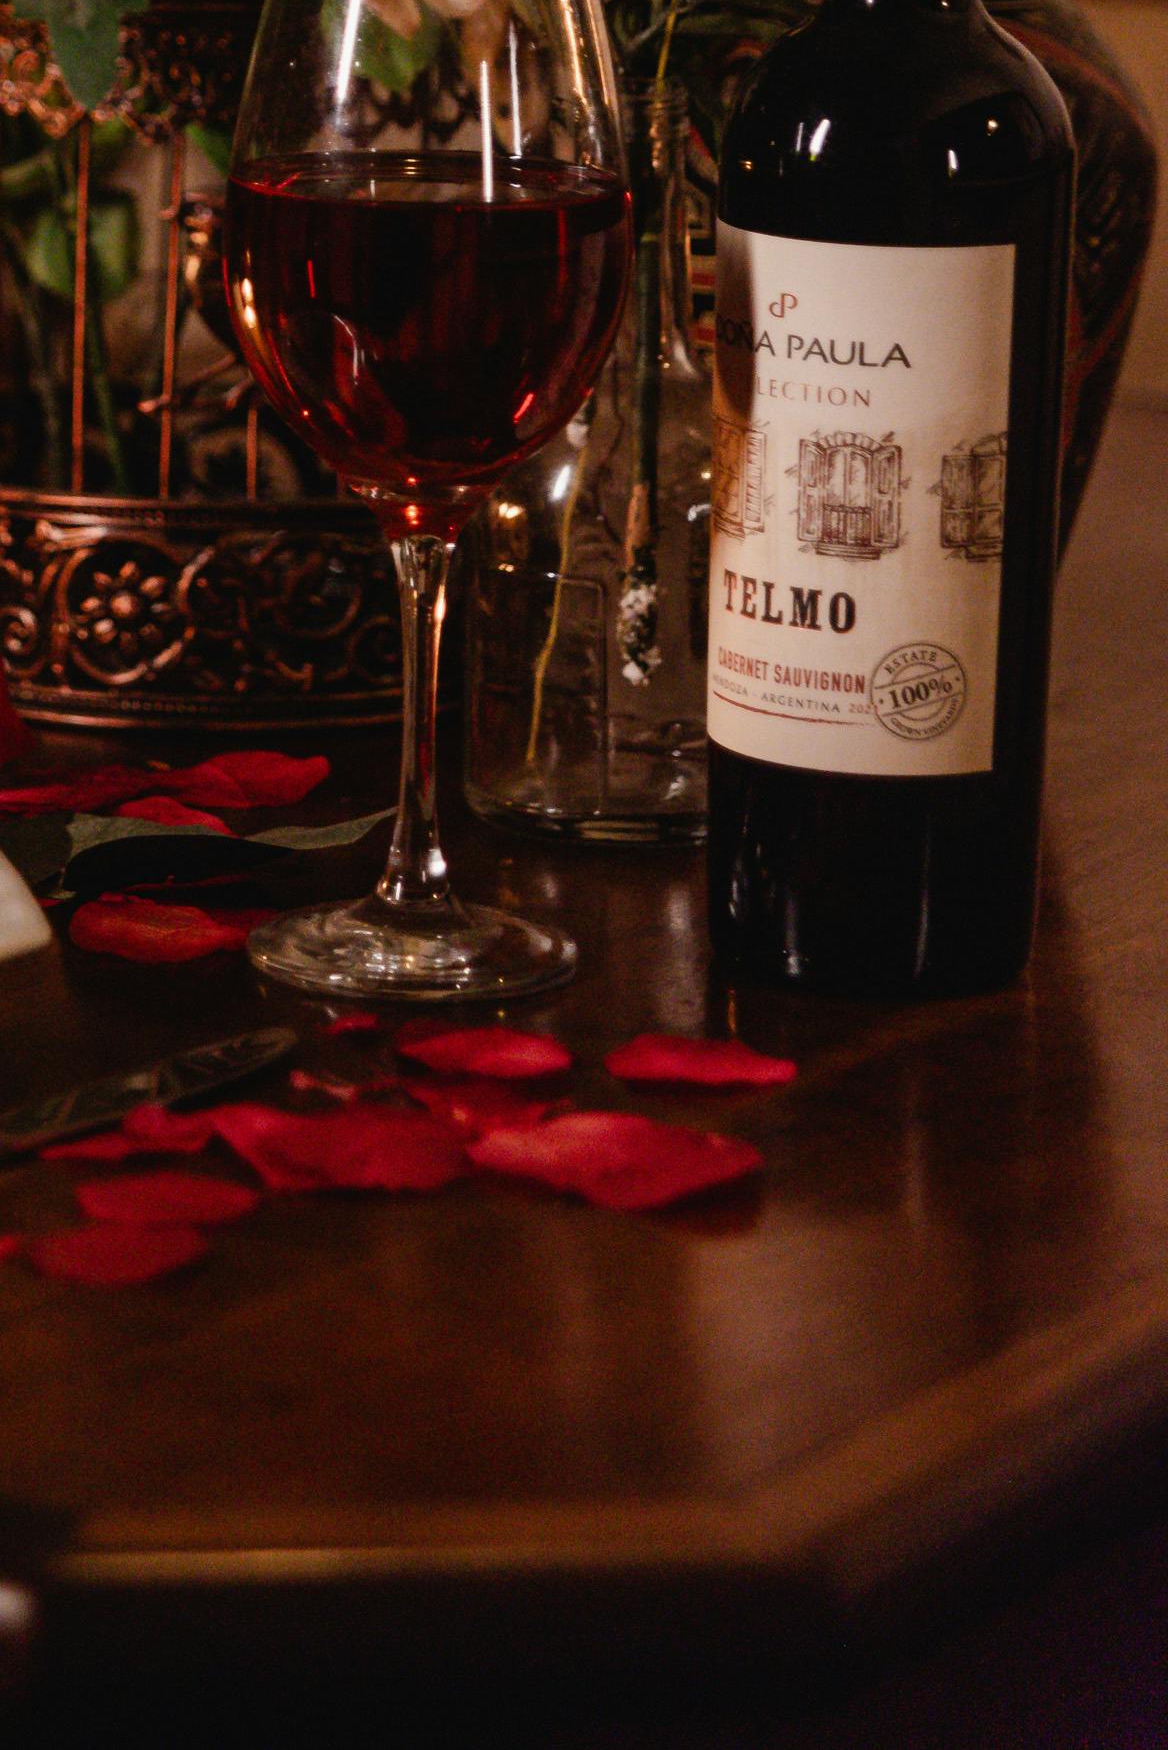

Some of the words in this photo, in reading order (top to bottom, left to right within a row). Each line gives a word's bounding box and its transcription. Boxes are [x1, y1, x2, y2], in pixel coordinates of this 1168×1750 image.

[786, 333, 912, 369] PAULA
[755, 375, 871, 408] LECTION
[723, 568, 856, 634] TELMO
[717, 646, 769, 682] CABERNET
[773, 663, 866, 694] SAUVIGNON
[884, 649, 938, 675] ESTATE
[760, 691, 841, 714] ARGENTINA
[888, 674, 953, 709] 100%
